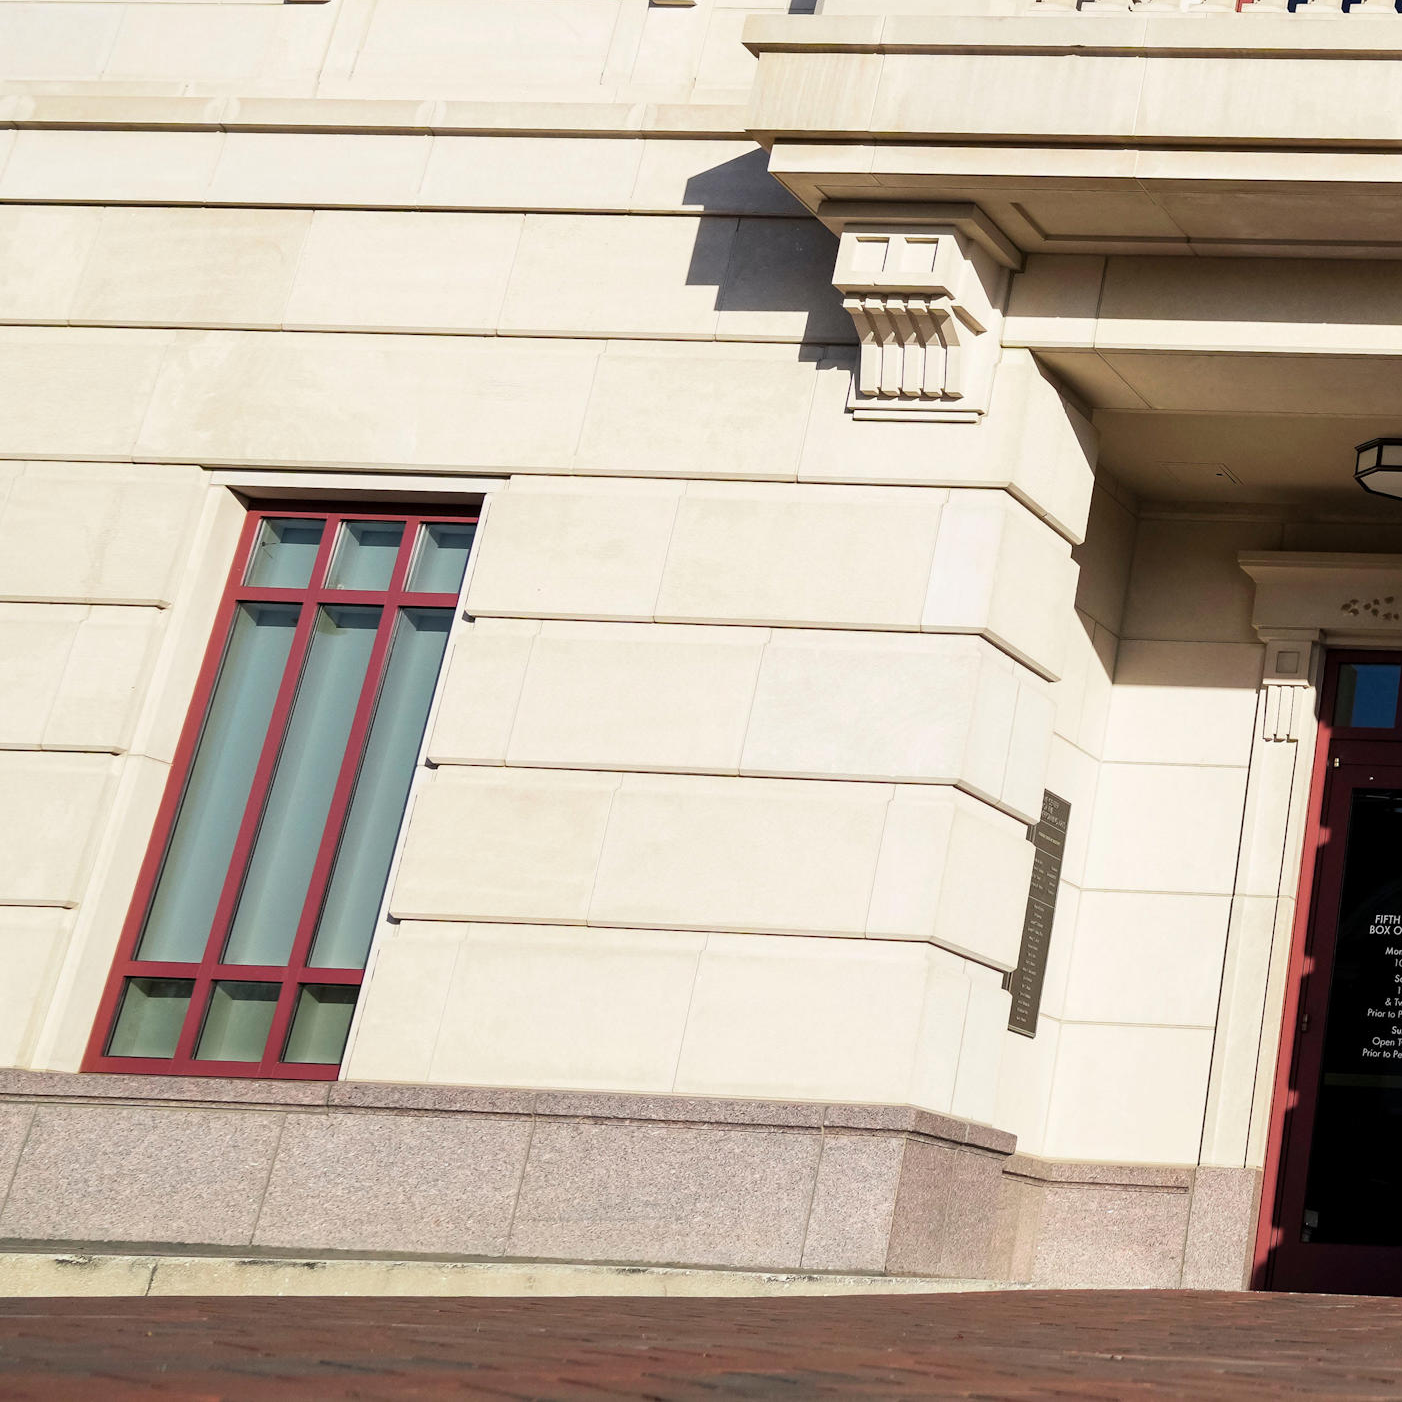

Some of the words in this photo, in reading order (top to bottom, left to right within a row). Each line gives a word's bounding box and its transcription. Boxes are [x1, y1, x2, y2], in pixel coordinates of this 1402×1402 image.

[1375, 915, 1400, 924] FIFTH
[1370, 925, 1391, 934] BOX
[1385, 998, 1391, 1006] &
[1367, 1008, 1386, 1017] Prior
[1372, 1037, 1395, 1048] Open
[1362, 1047, 1381, 1057] Prior
